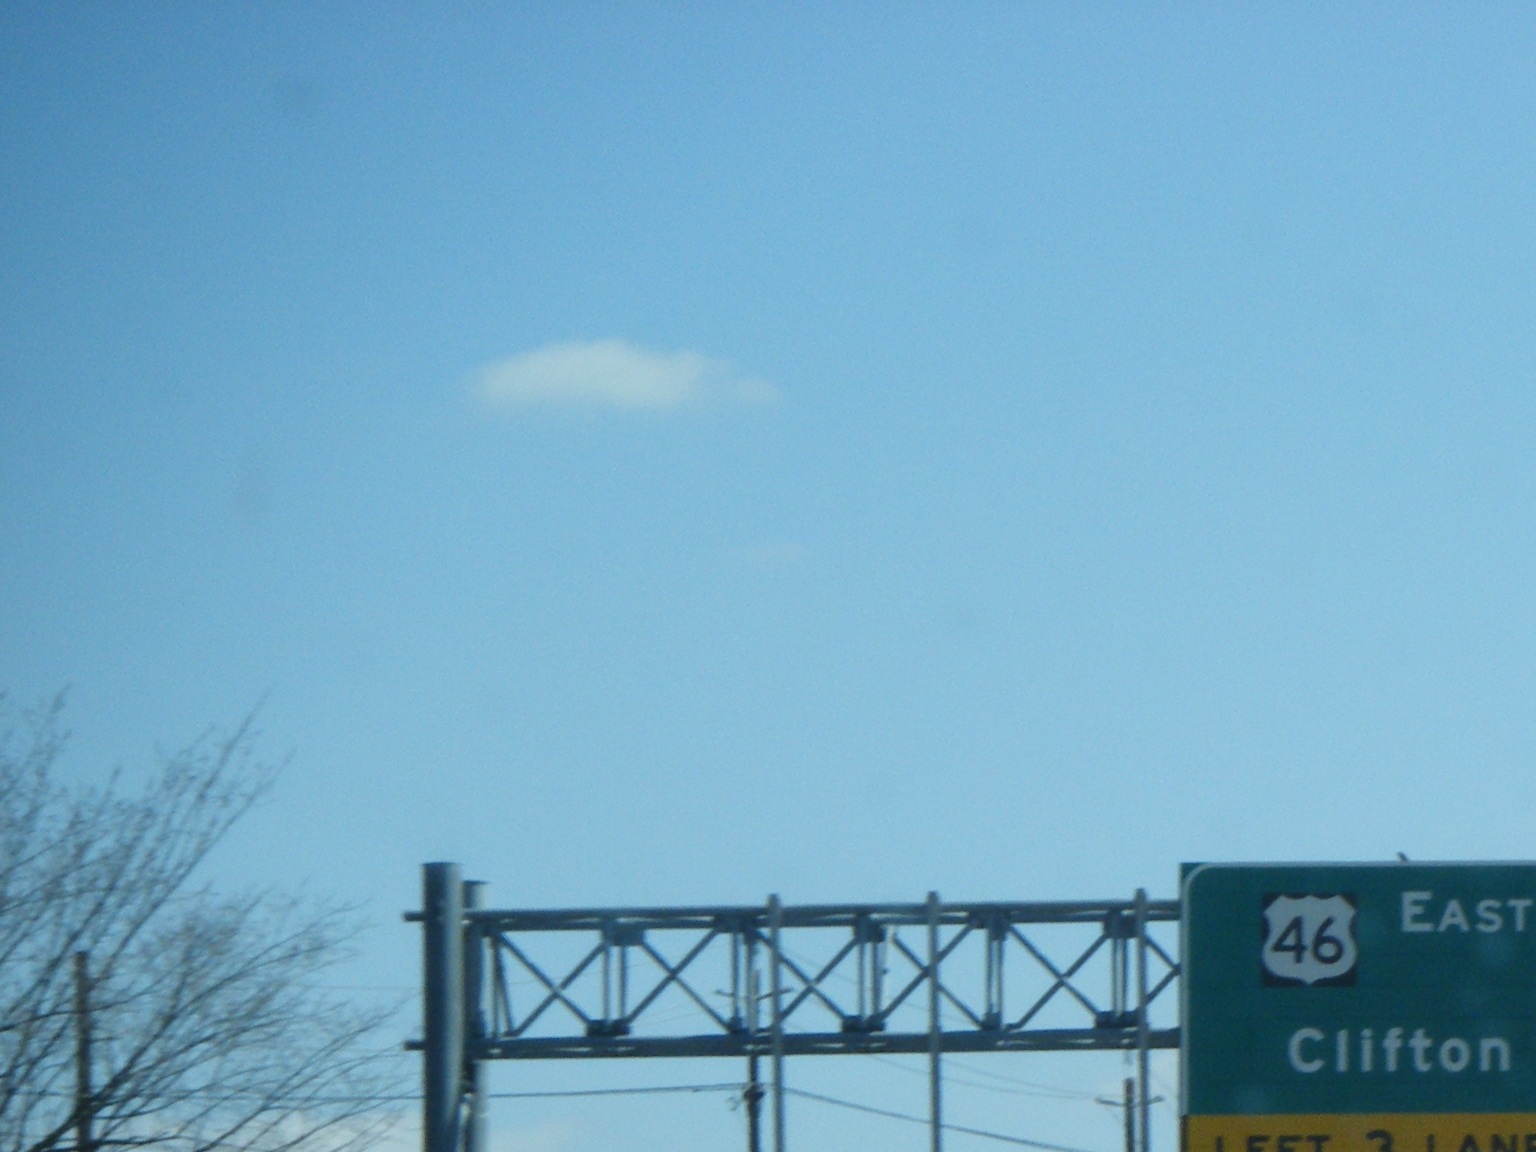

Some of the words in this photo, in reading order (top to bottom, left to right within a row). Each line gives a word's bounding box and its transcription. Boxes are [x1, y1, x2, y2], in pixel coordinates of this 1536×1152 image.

[1270, 915, 1344, 965] 46
[1401, 891, 1533, 933] EAST
[1288, 1027, 1511, 1073] Clifton
